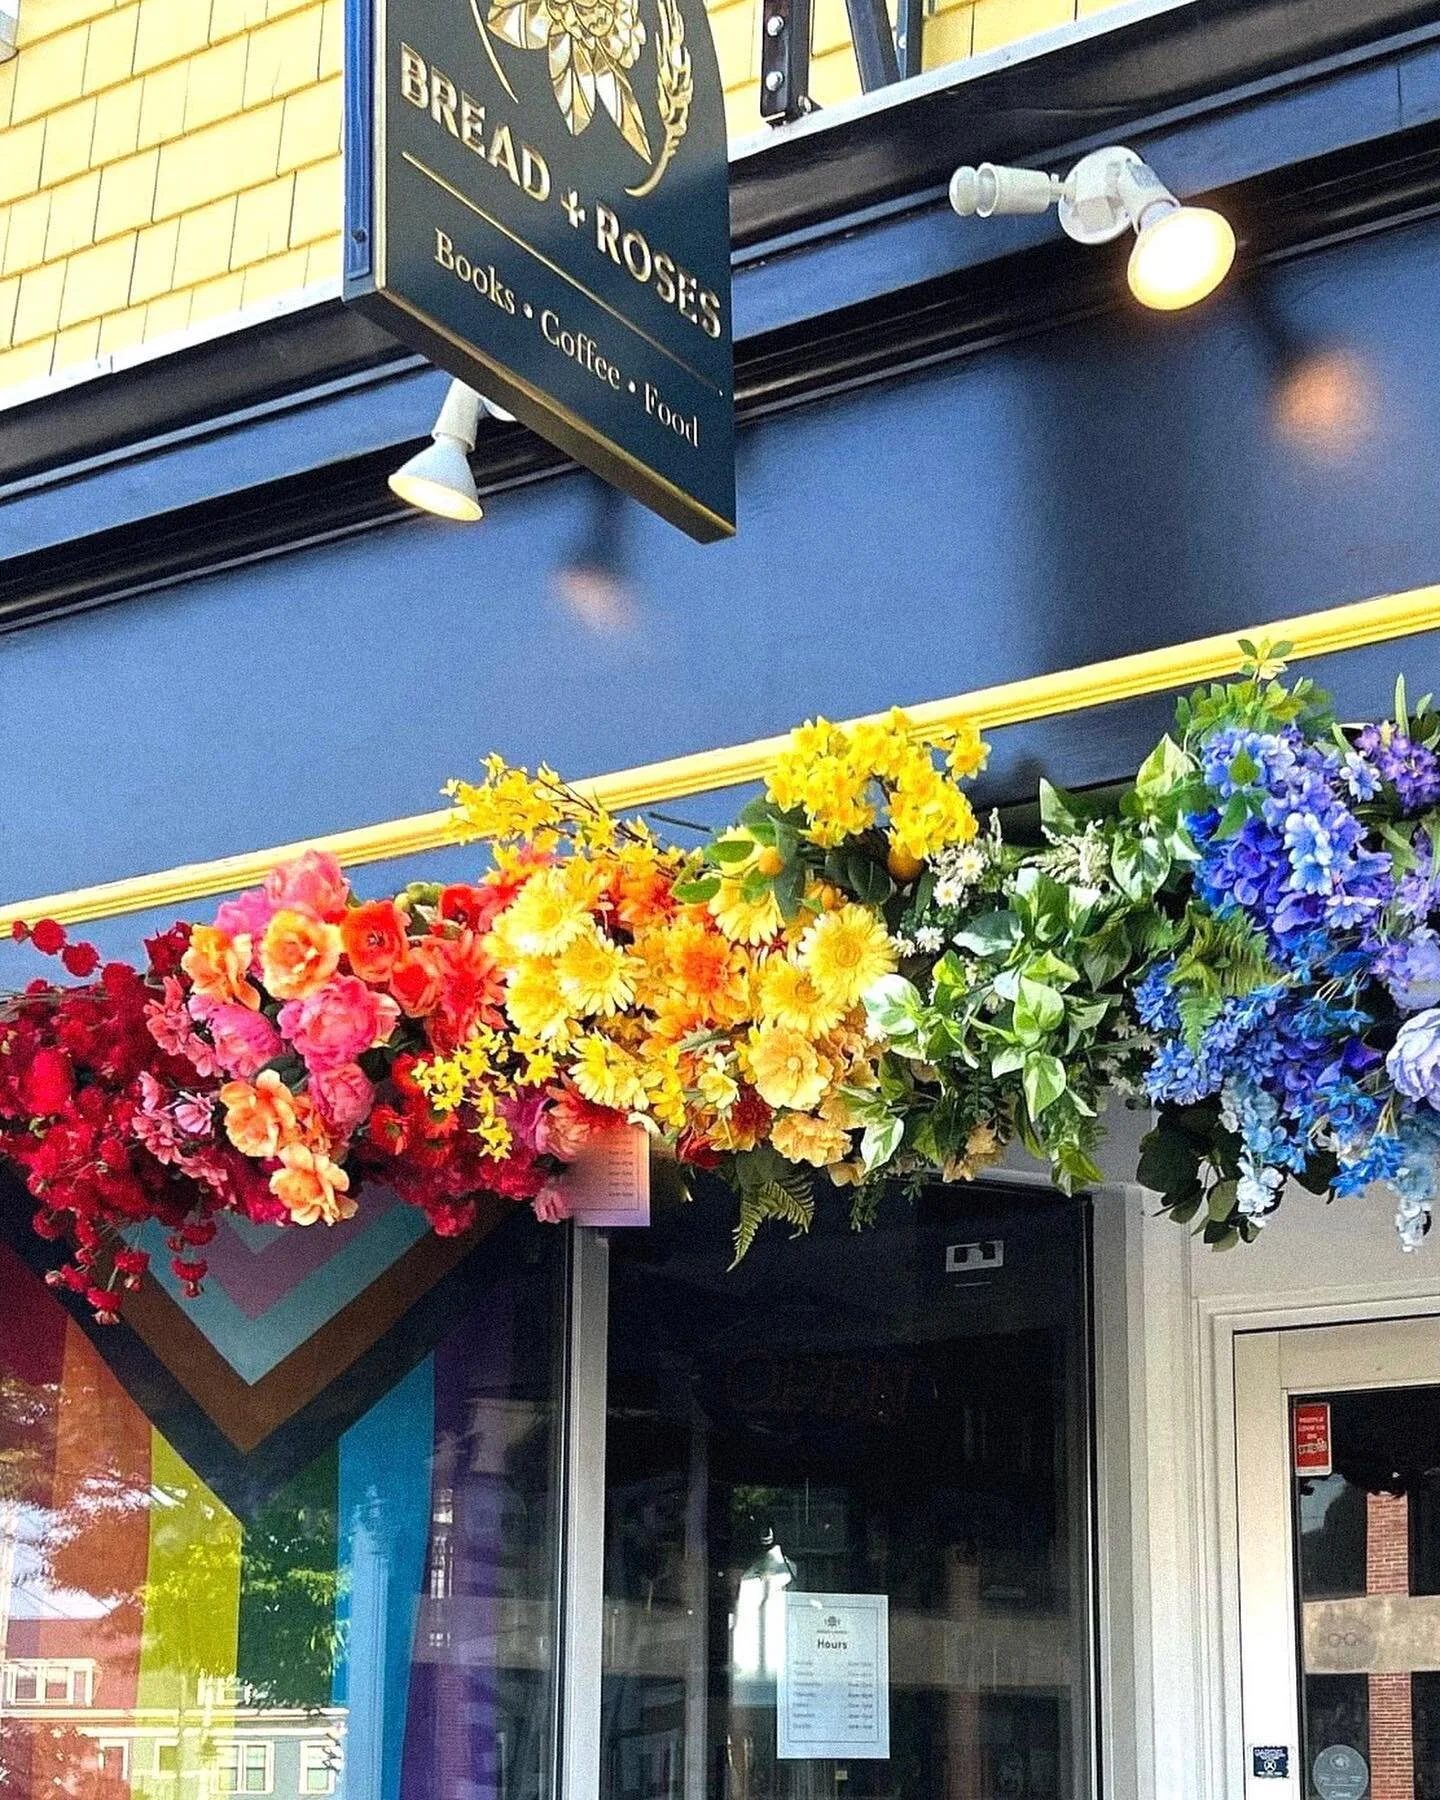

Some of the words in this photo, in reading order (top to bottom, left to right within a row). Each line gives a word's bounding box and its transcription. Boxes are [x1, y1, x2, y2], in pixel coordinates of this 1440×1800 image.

[401, 41, 550, 202] BREAD
[596, 201, 721, 338] ROSES
[434, 226, 515, 314] Books
[541, 310, 620, 390] Coffee
[645, 383, 699, 448] Food
[817, 1638, 848, 1650] Hours
